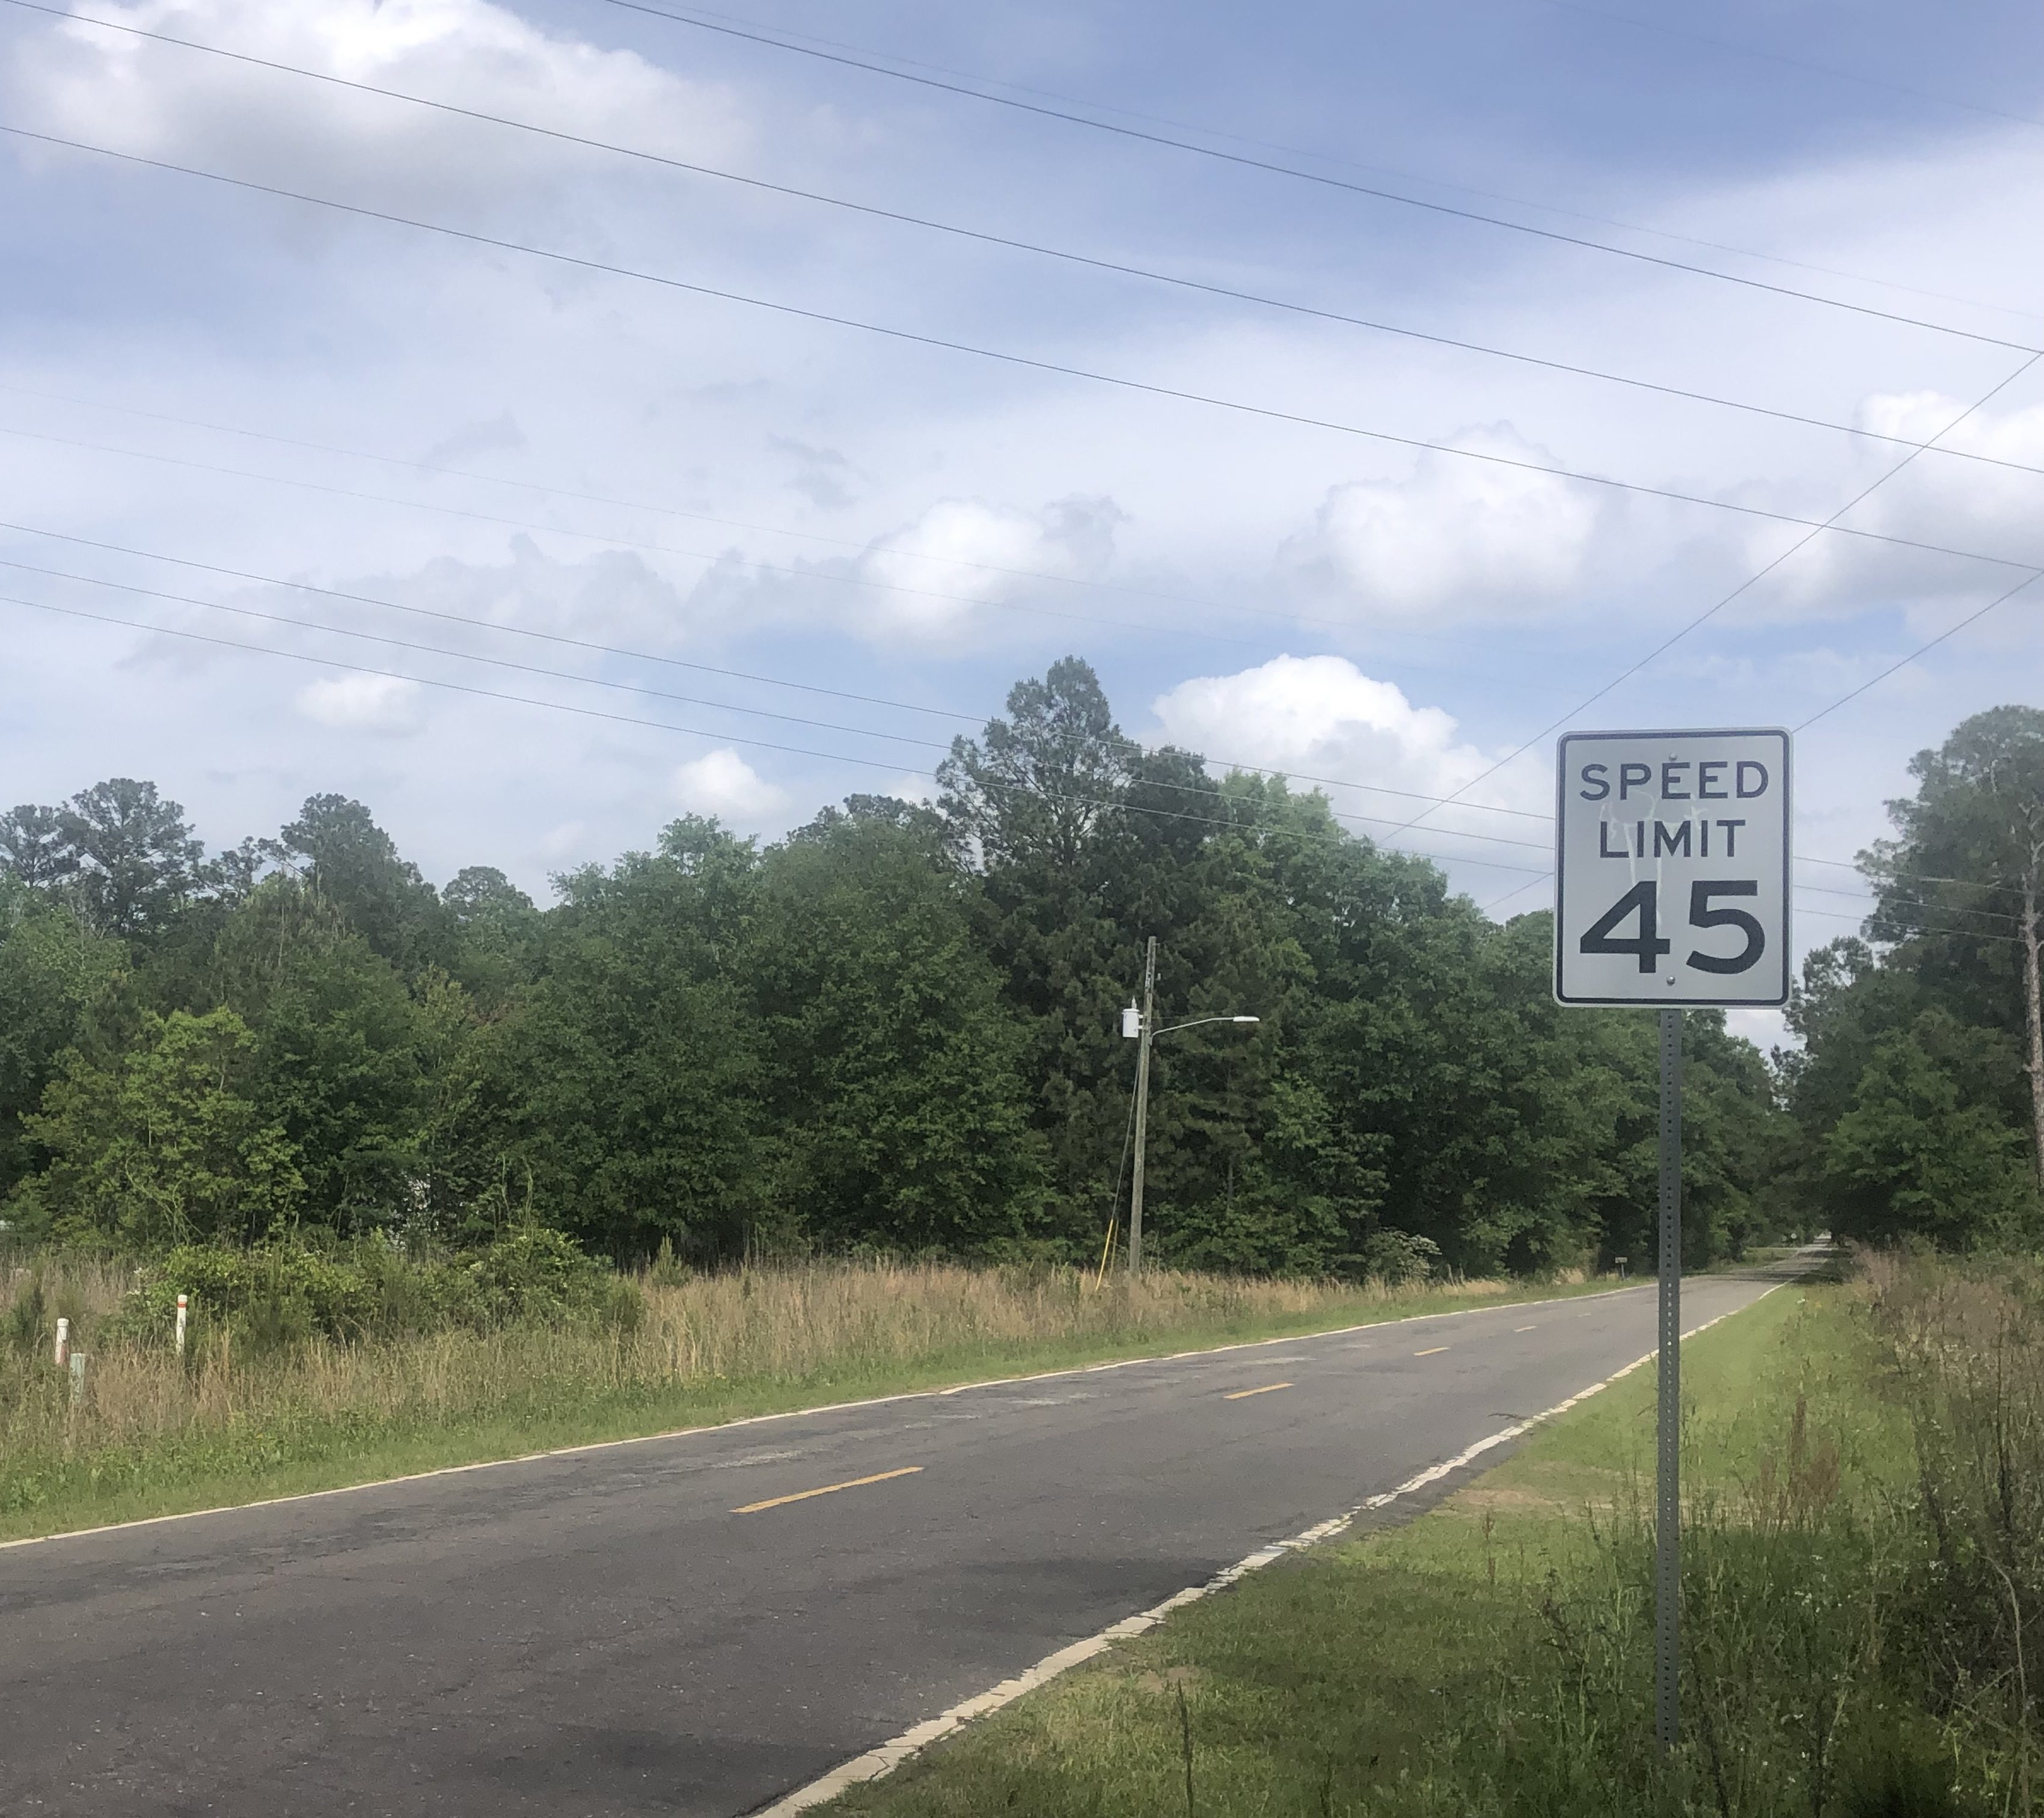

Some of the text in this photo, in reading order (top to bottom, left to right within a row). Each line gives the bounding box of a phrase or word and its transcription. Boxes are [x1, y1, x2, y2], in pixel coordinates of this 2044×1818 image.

[1579, 761, 1769, 801] SPEED
[1600, 819, 1746, 858] LIMIT
[1579, 880, 1766, 975] 45
